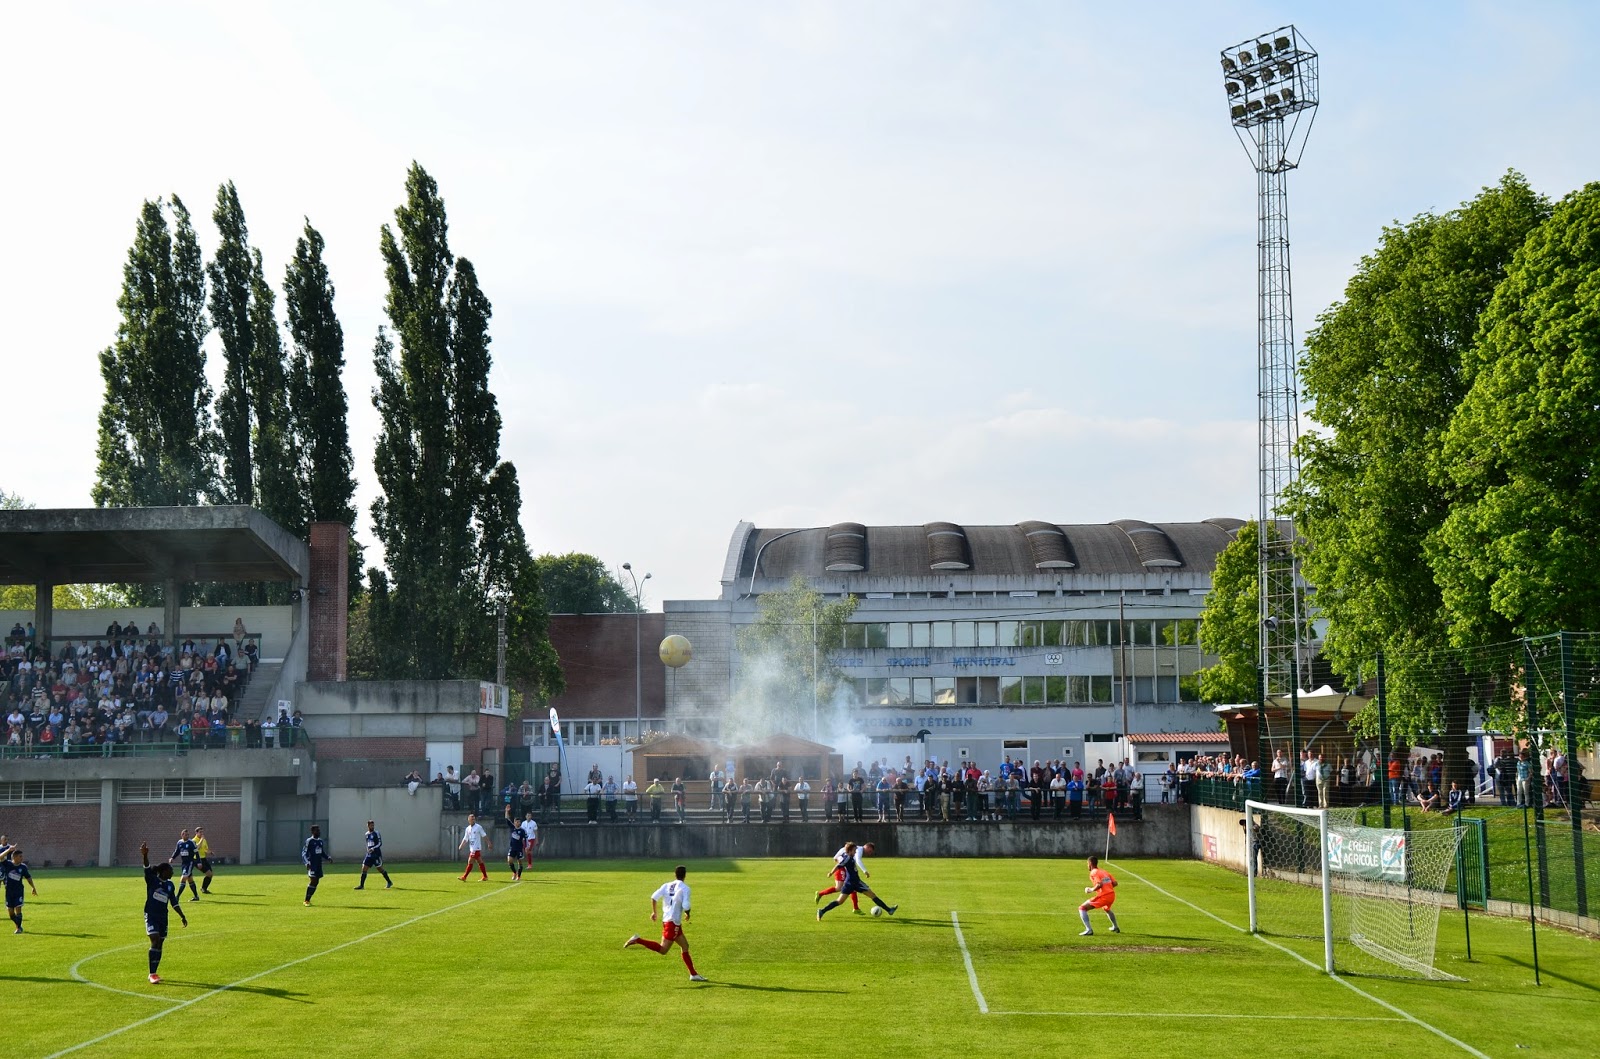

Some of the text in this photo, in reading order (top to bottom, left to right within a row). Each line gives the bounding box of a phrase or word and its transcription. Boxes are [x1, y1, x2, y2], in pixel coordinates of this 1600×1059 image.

[887, 656, 931, 667] SPORTIF
[953, 656, 1016, 667] MUNICIPAL
[919, 715, 973, 727] TÉTELIN
